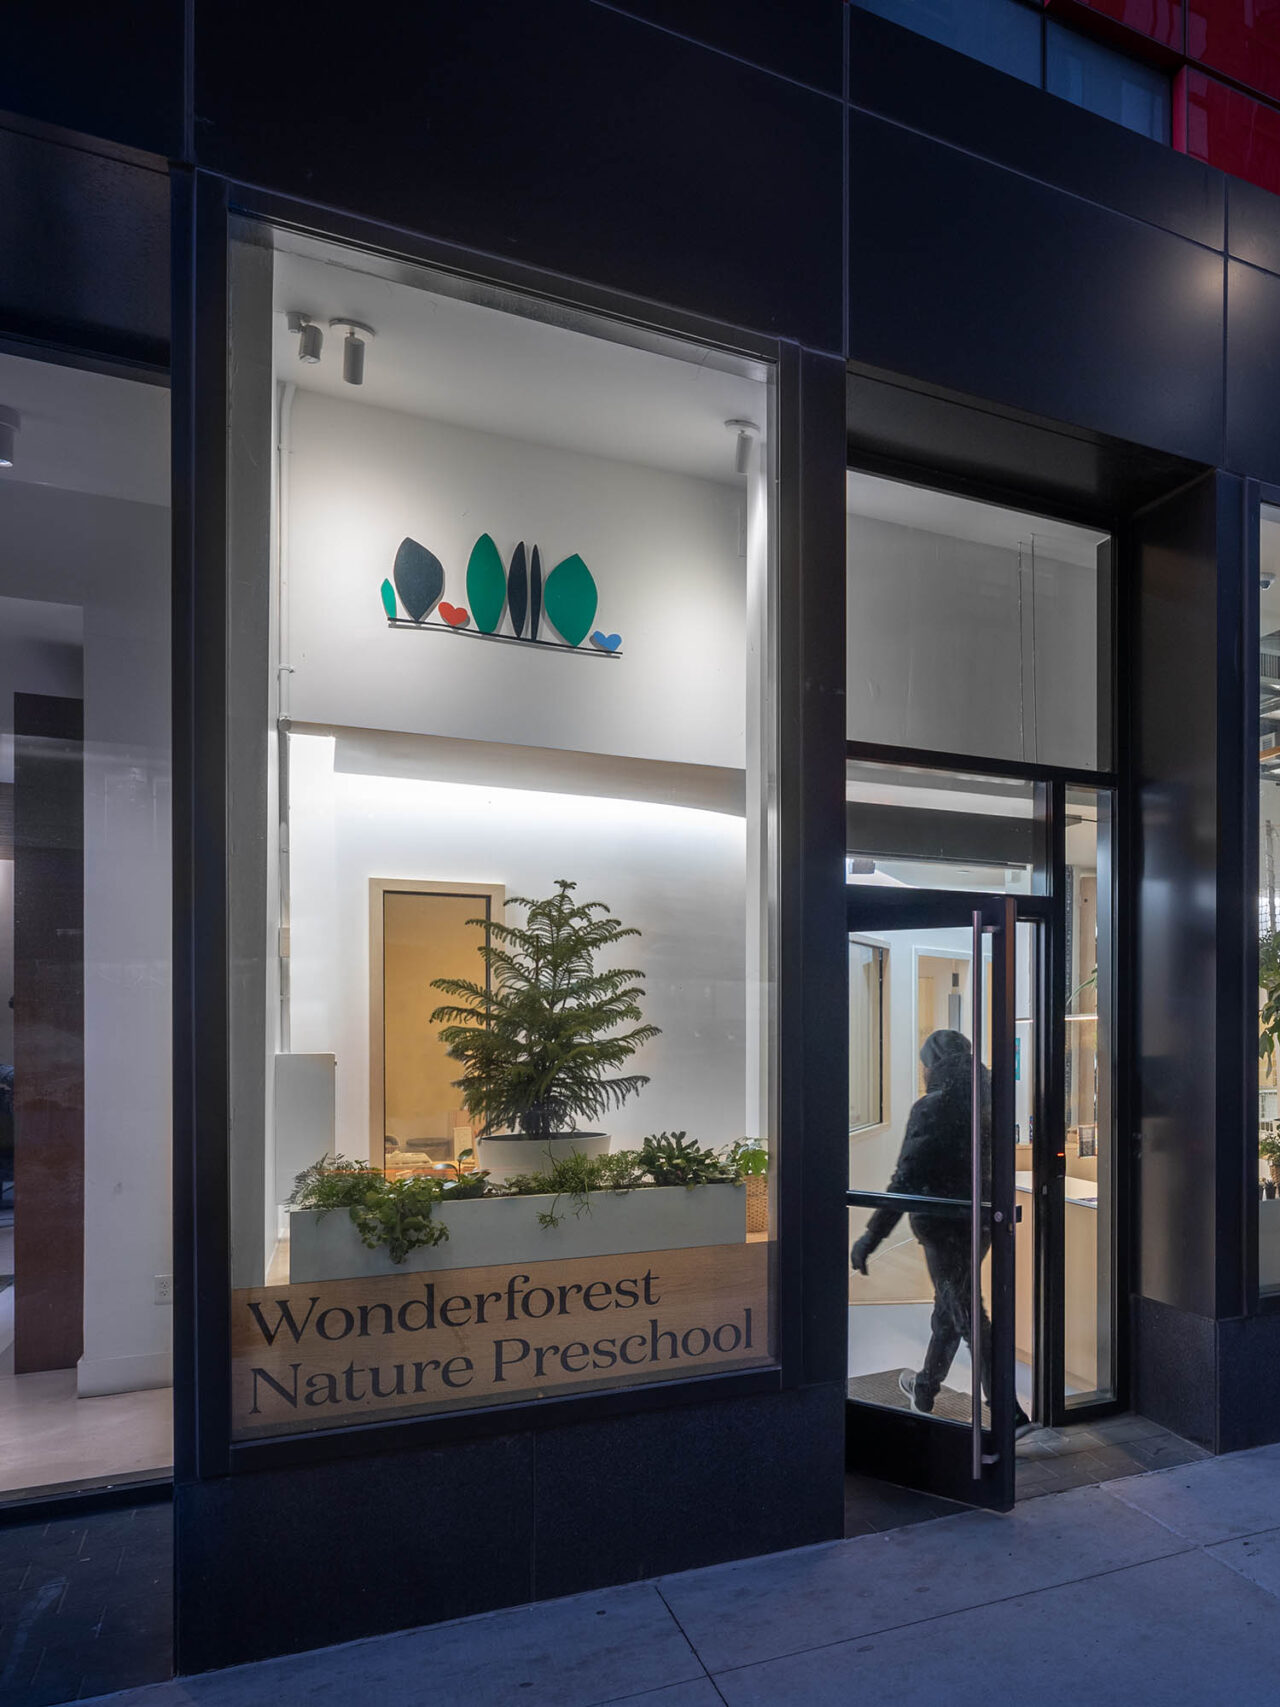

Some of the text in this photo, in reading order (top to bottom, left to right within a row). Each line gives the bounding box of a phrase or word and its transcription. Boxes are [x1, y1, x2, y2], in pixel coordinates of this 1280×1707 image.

[247, 1269, 661, 1346] Wonderforest
[249, 1308, 753, 1415] Nature Preschool
